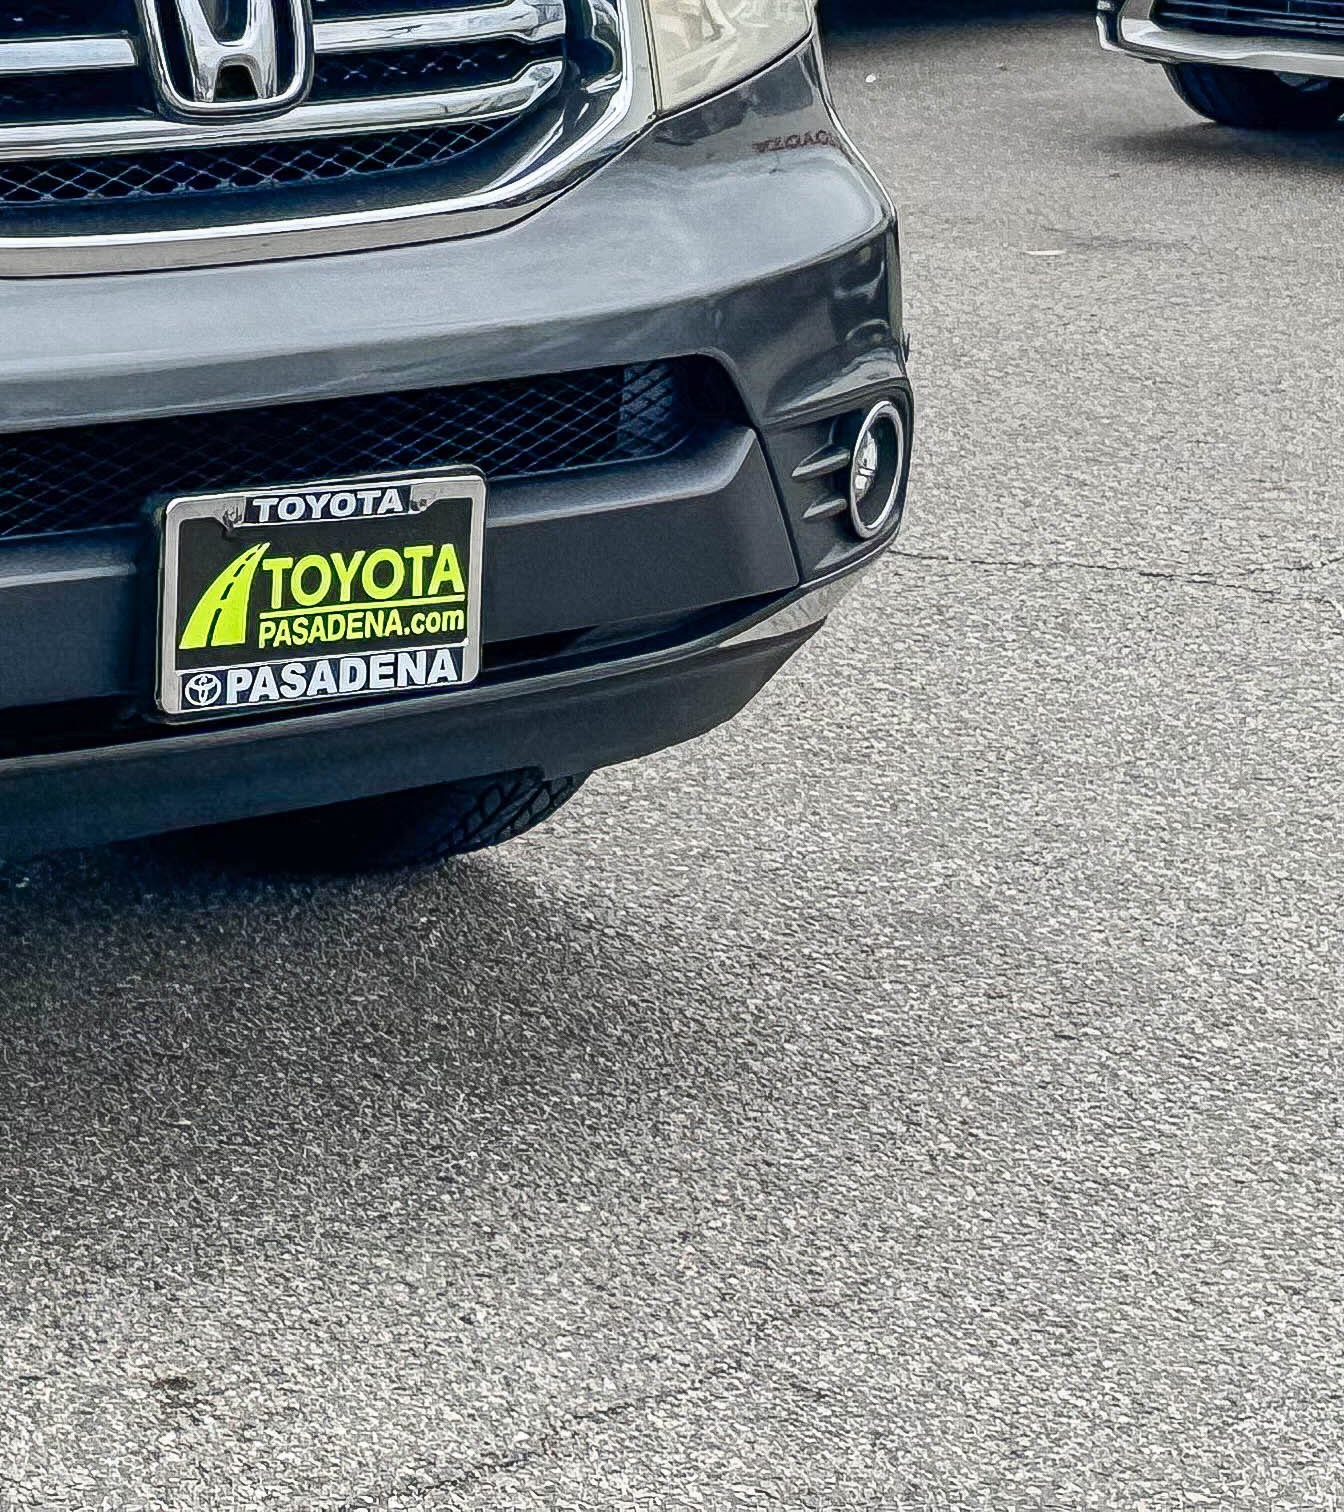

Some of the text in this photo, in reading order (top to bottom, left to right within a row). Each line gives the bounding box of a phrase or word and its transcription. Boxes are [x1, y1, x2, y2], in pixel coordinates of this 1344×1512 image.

[252, 488, 404, 523] TOYOTA
[262, 543, 466, 609] TOYOTA
[258, 609, 465, 649] PASADENA.com
[226, 649, 458, 704] PASADENA
